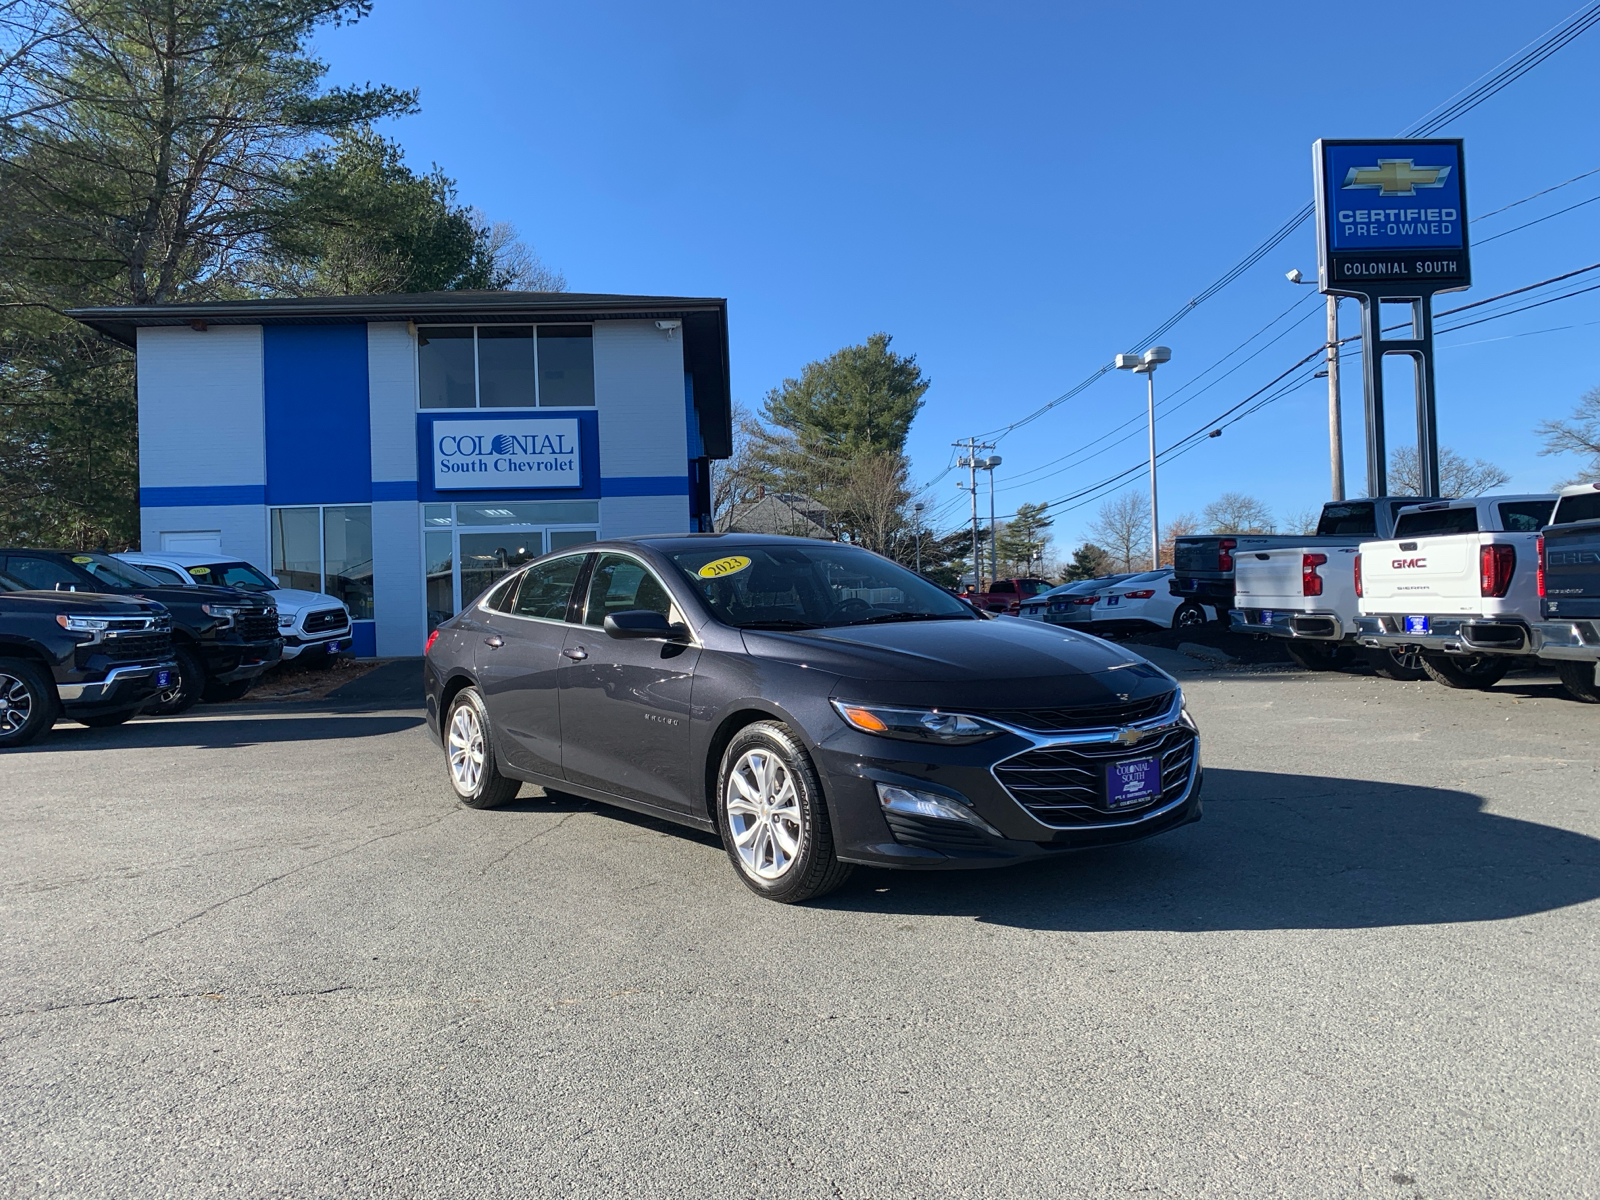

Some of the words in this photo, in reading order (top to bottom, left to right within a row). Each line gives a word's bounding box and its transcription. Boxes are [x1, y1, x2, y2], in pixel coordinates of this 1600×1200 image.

[1338, 208, 1457, 223] CERTIFIED
[1345, 223, 1452, 236] PRE-OWNED
[1344, 262, 1408, 275] COLONIAL
[1416, 261, 1457, 274] SOUTH
[439, 434, 574, 456] COLONIAL
[440, 459, 488, 473] South
[494, 458, 574, 472] Chevrolet
[707, 558, 742, 575] 2023
[1391, 557, 1427, 569] GMC
[1117, 763, 1150, 775] COLONIAL
[1122, 772, 1145, 783] SOUTH
